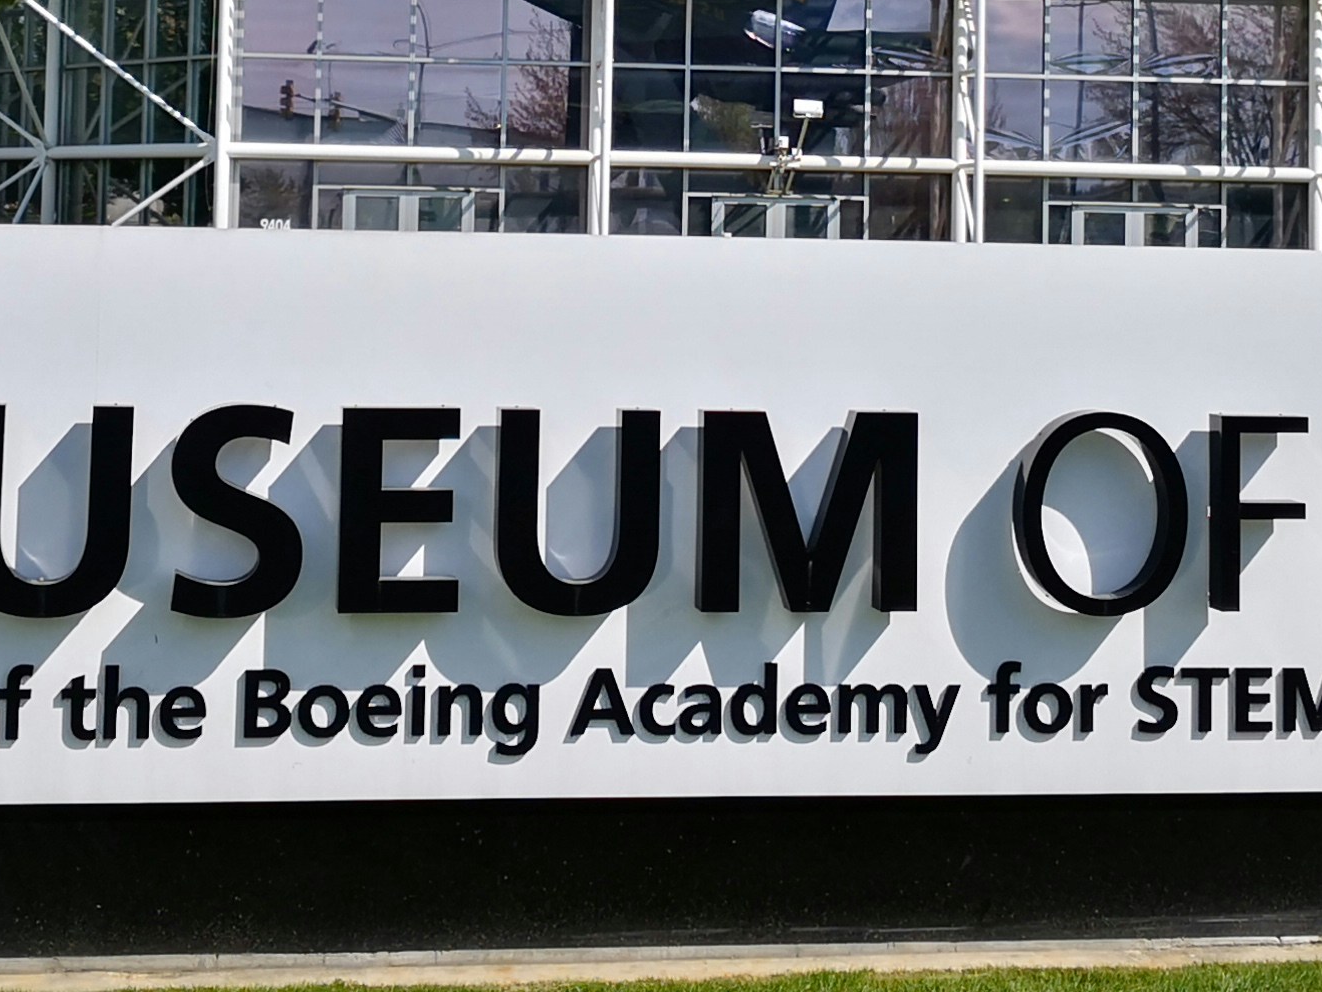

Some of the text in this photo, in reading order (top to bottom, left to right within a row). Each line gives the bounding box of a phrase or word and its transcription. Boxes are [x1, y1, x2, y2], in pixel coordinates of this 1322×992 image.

[1013, 411, 1308, 616] OF
[61, 664, 207, 741] the
[243, 664, 540, 756] Boeing
[571, 662, 961, 754] Academy
[988, 660, 1109, 734] for
